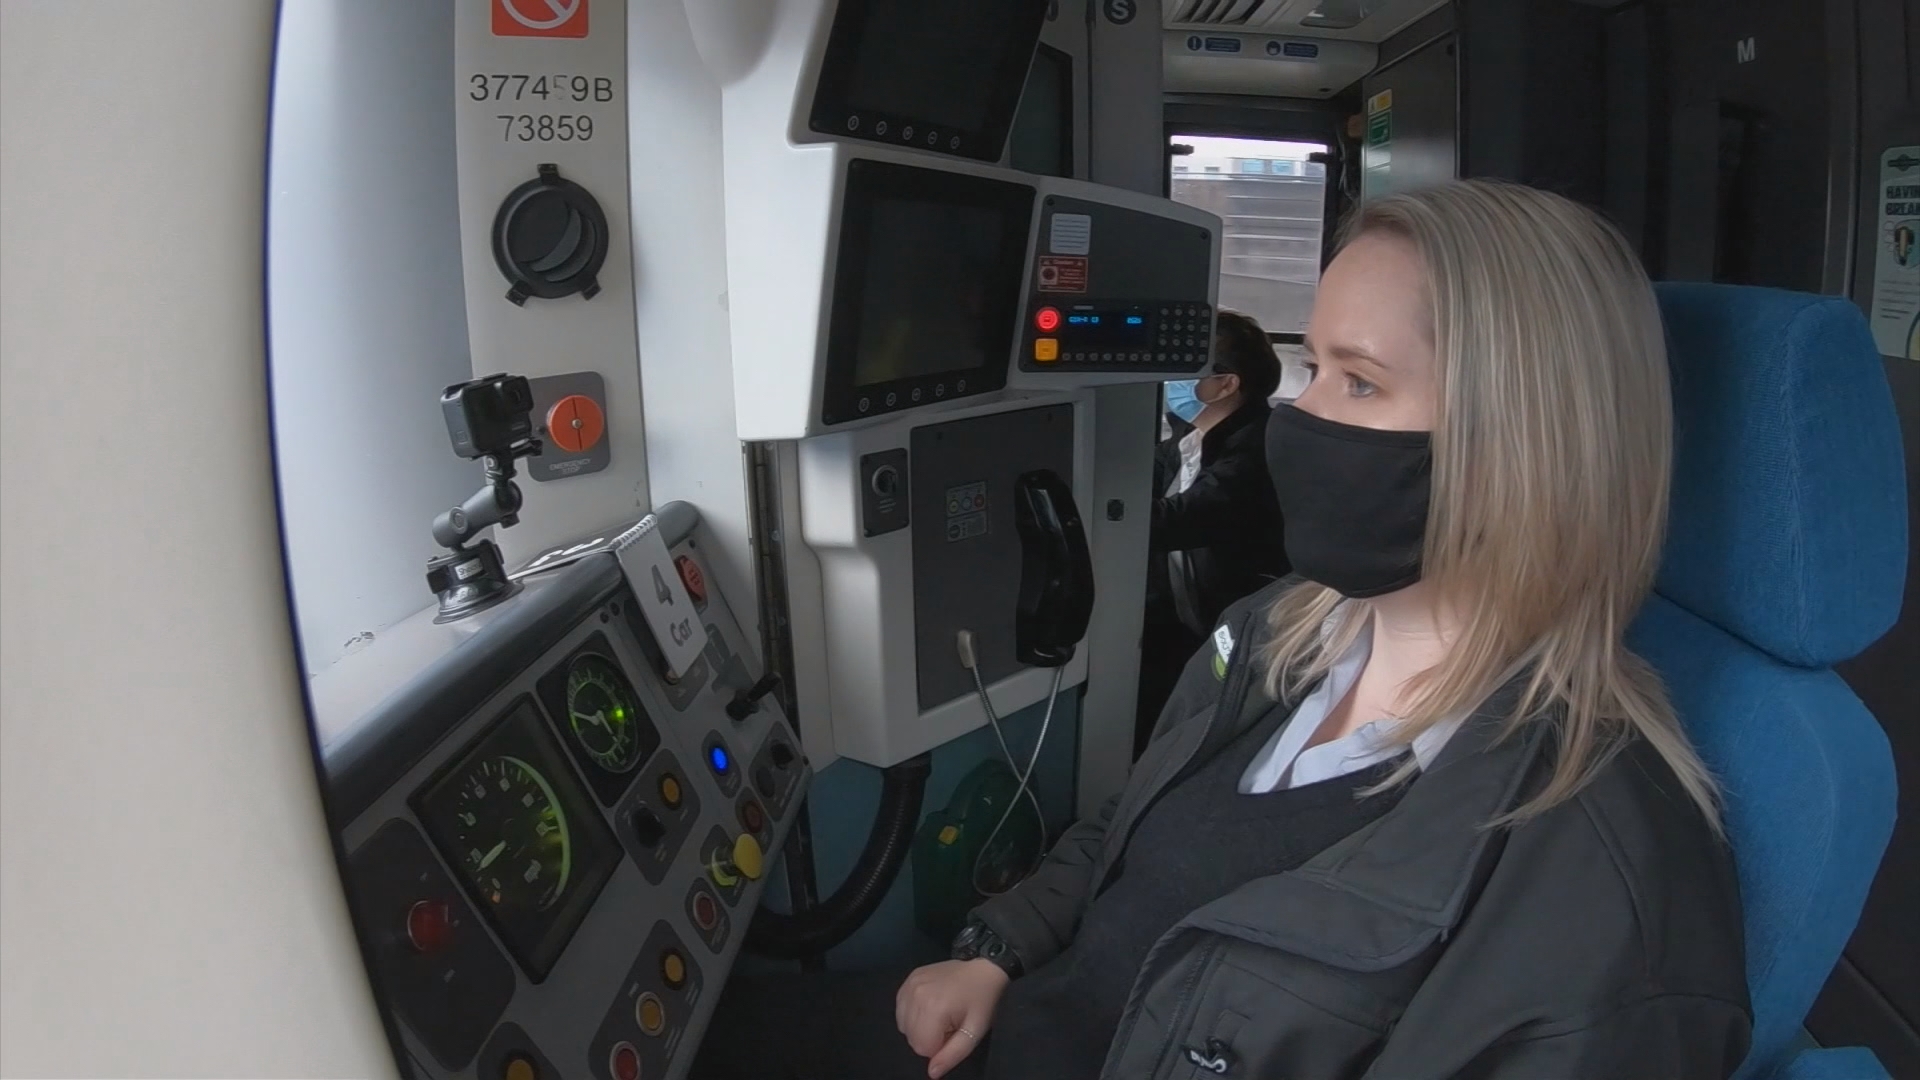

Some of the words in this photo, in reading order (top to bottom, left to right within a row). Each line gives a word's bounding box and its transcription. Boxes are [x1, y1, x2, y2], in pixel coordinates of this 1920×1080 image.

[1737, 36, 1755, 64] M
[470, 74, 613, 102] 377459B
[497, 114, 593, 142] 73859
[651, 564, 674, 607] 4
[670, 618, 692, 648] Car
